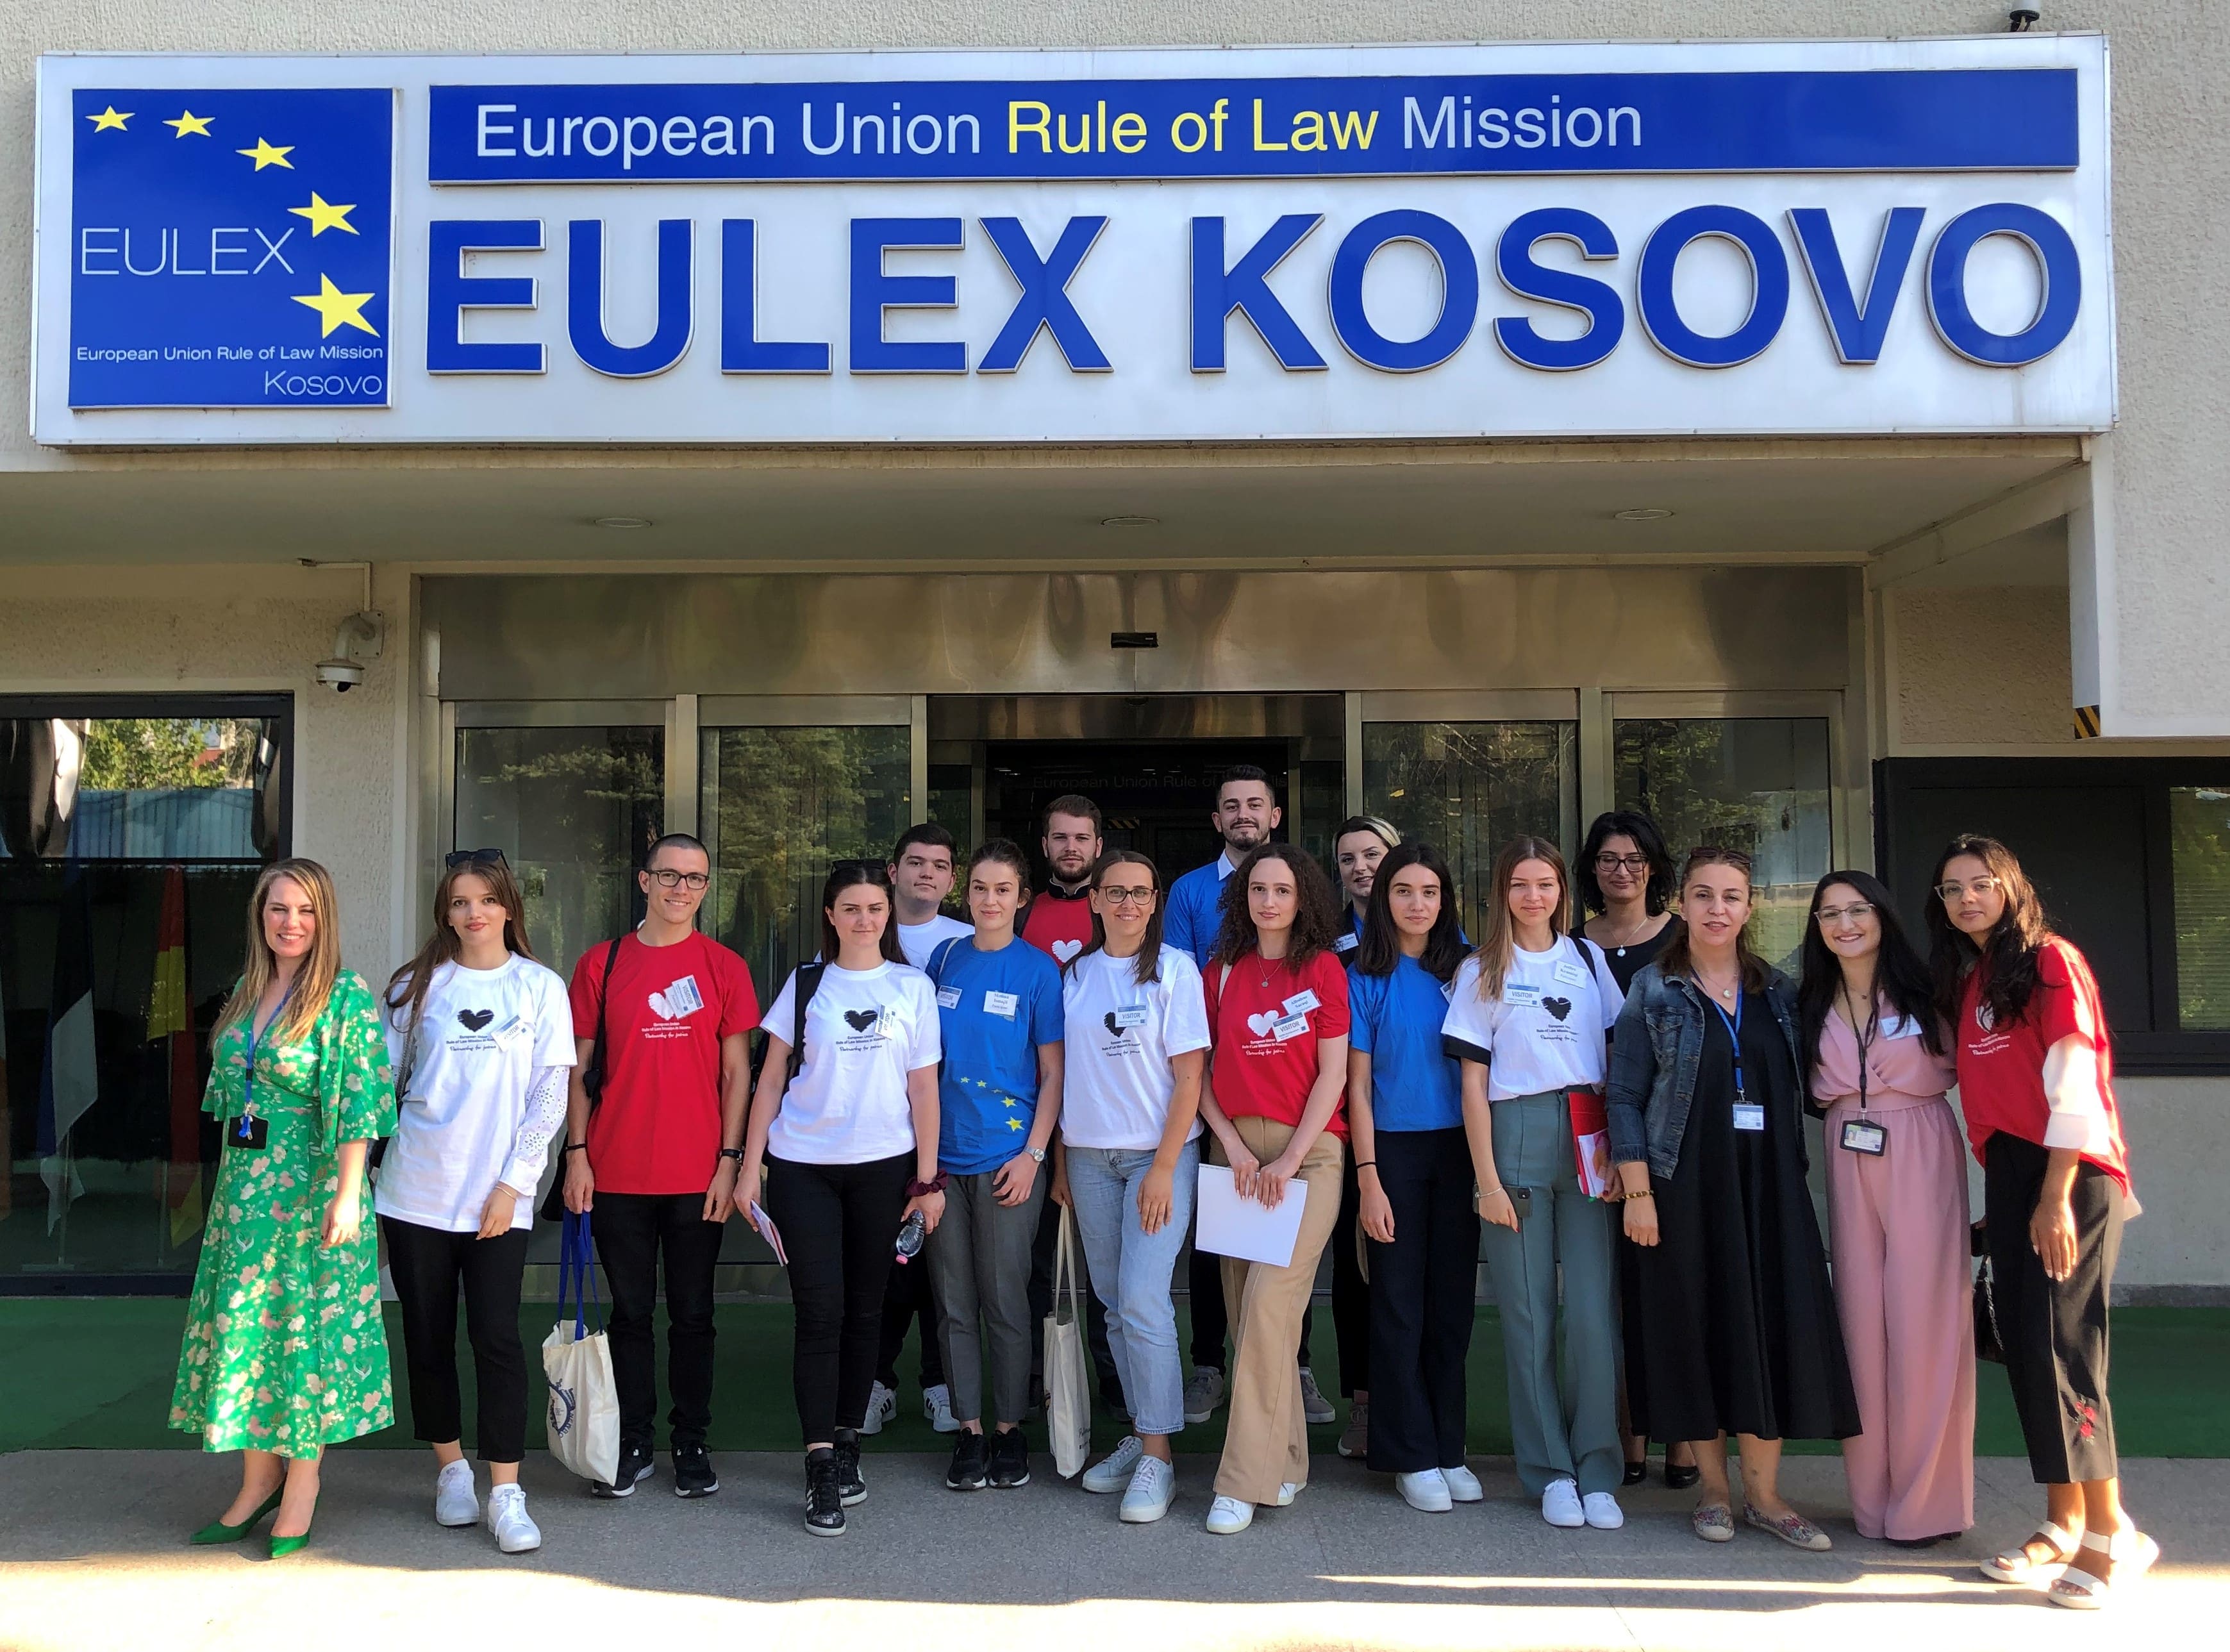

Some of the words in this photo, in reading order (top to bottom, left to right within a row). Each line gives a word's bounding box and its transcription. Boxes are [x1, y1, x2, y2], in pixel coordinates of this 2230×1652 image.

[478, 104, 774, 170] European
[803, 102, 979, 155] Union
[1009, 100, 1147, 154] Rule
[1171, 98, 1229, 153] of
[1253, 98, 1379, 152] Law
[1404, 95, 1641, 149] Mission
[81, 228, 294, 276] EULEX
[426, 216, 1113, 378] EULEX
[1190, 204, 2082, 370] KOSOVO
[77, 346, 158, 363] European
[164, 346, 212, 361] Union
[217, 346, 254, 360] Rule
[258, 346, 276, 360] of
[280, 346, 315, 360] Law
[320, 346, 383, 359] Mission
[265, 370, 383, 396] Kosovo
[1033, 776, 1108, 790] European
[1114, 776, 1158, 788] Union
[1164, 776, 1196, 788] Rule
[1202, 775, 1217, 787] of
[1279, 1021, 1301, 1032] VISITOR
